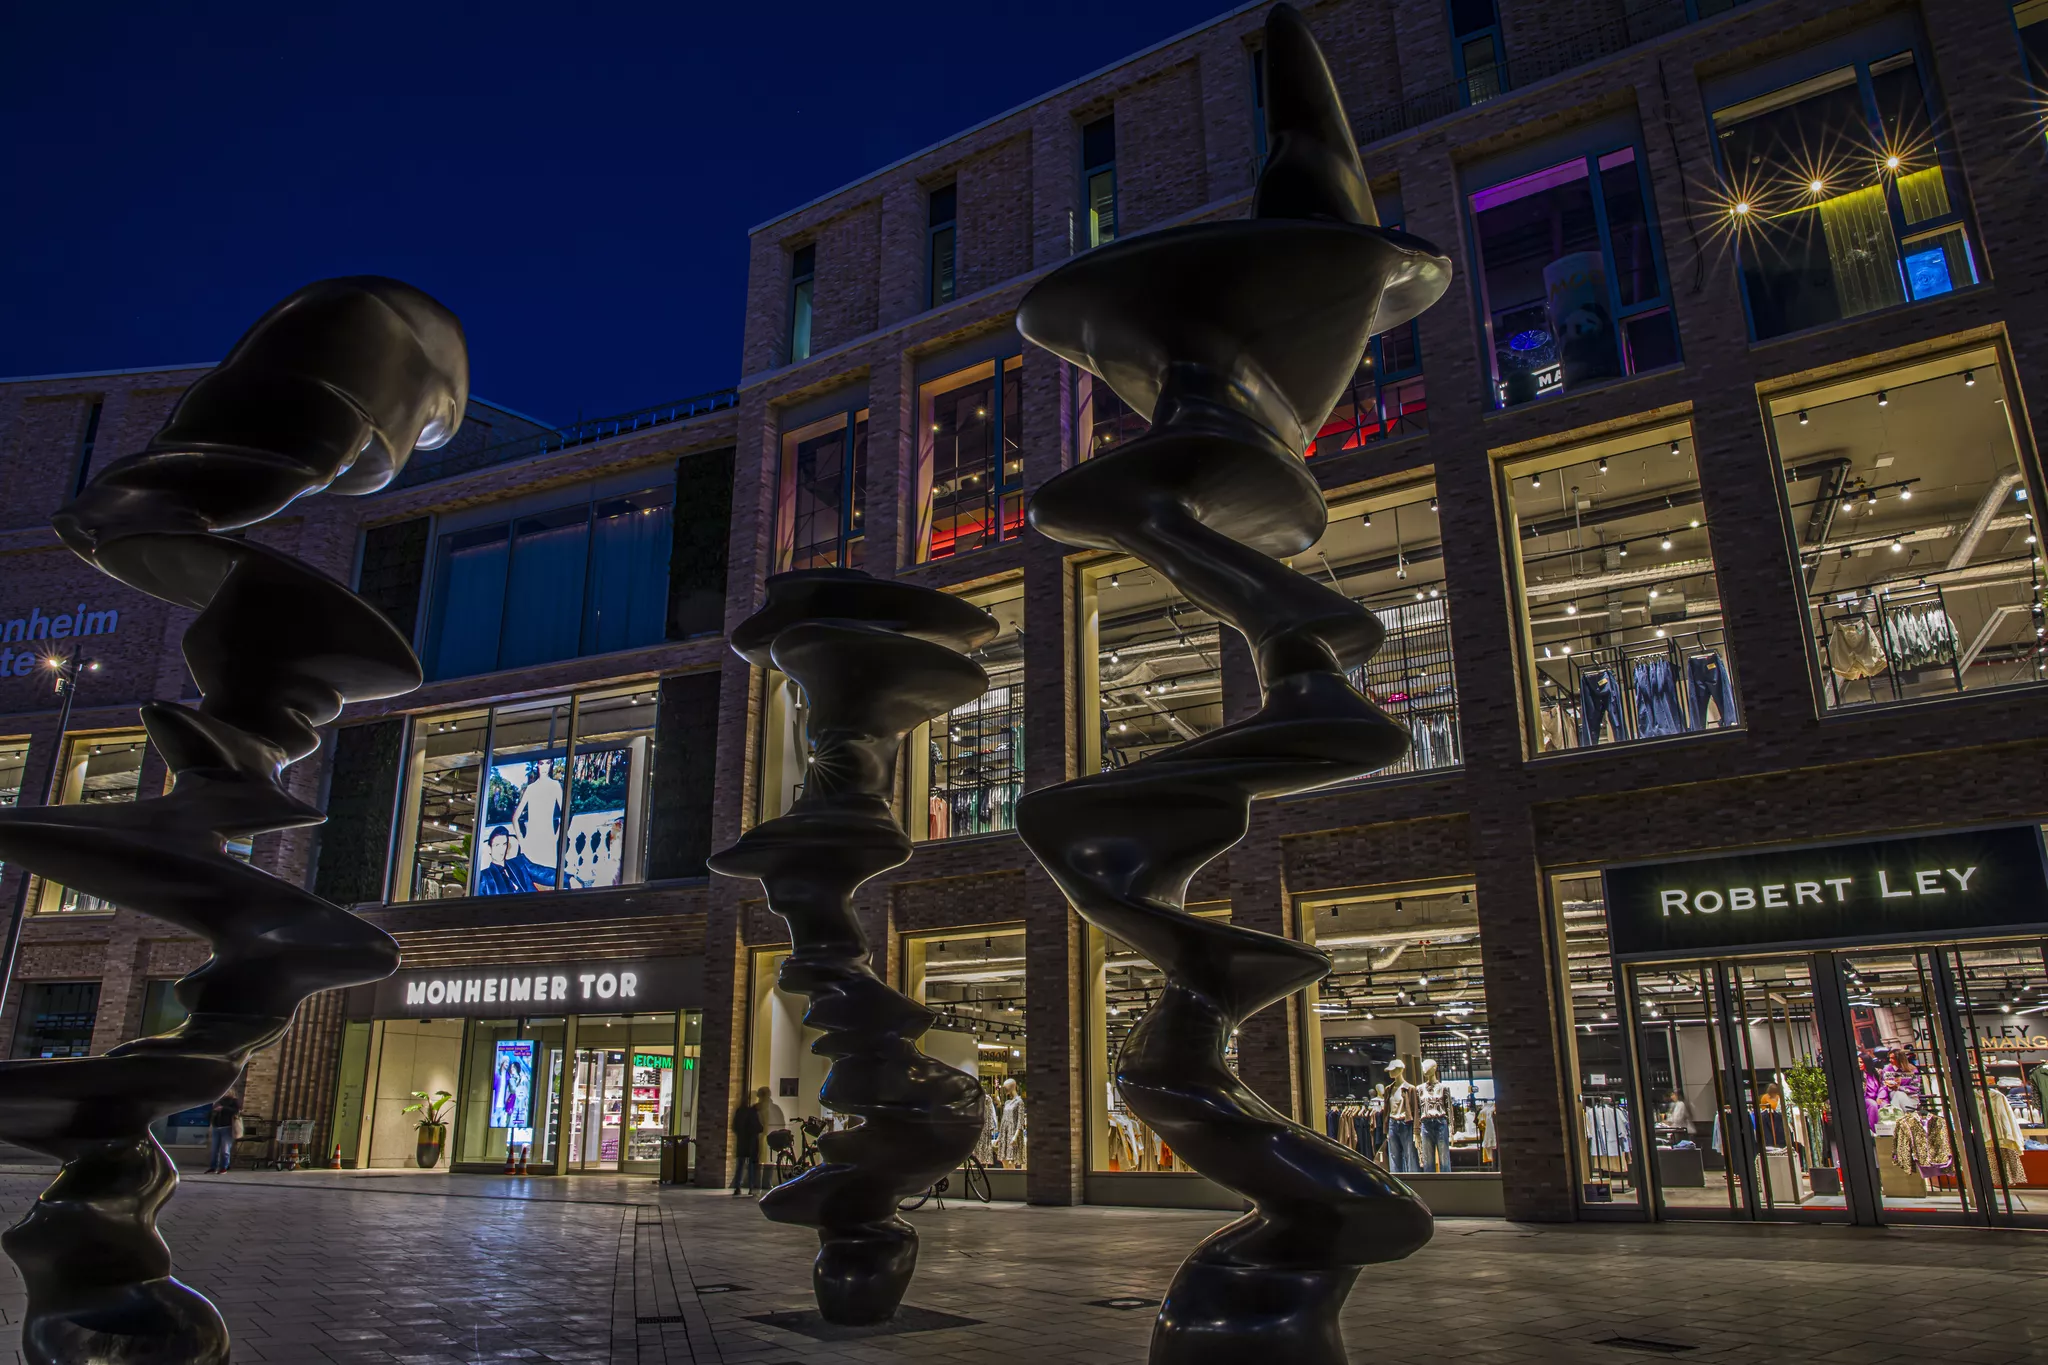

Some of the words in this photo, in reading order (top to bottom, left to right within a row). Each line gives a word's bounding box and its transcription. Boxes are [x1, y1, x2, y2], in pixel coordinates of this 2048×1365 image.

[0, 603, 118, 643] nheim
[1660, 878, 1852, 917] ROBERT
[1877, 866, 1977, 898] LEY
[406, 975, 568, 1005] MONHEIMER
[580, 972, 638, 999] TOR
